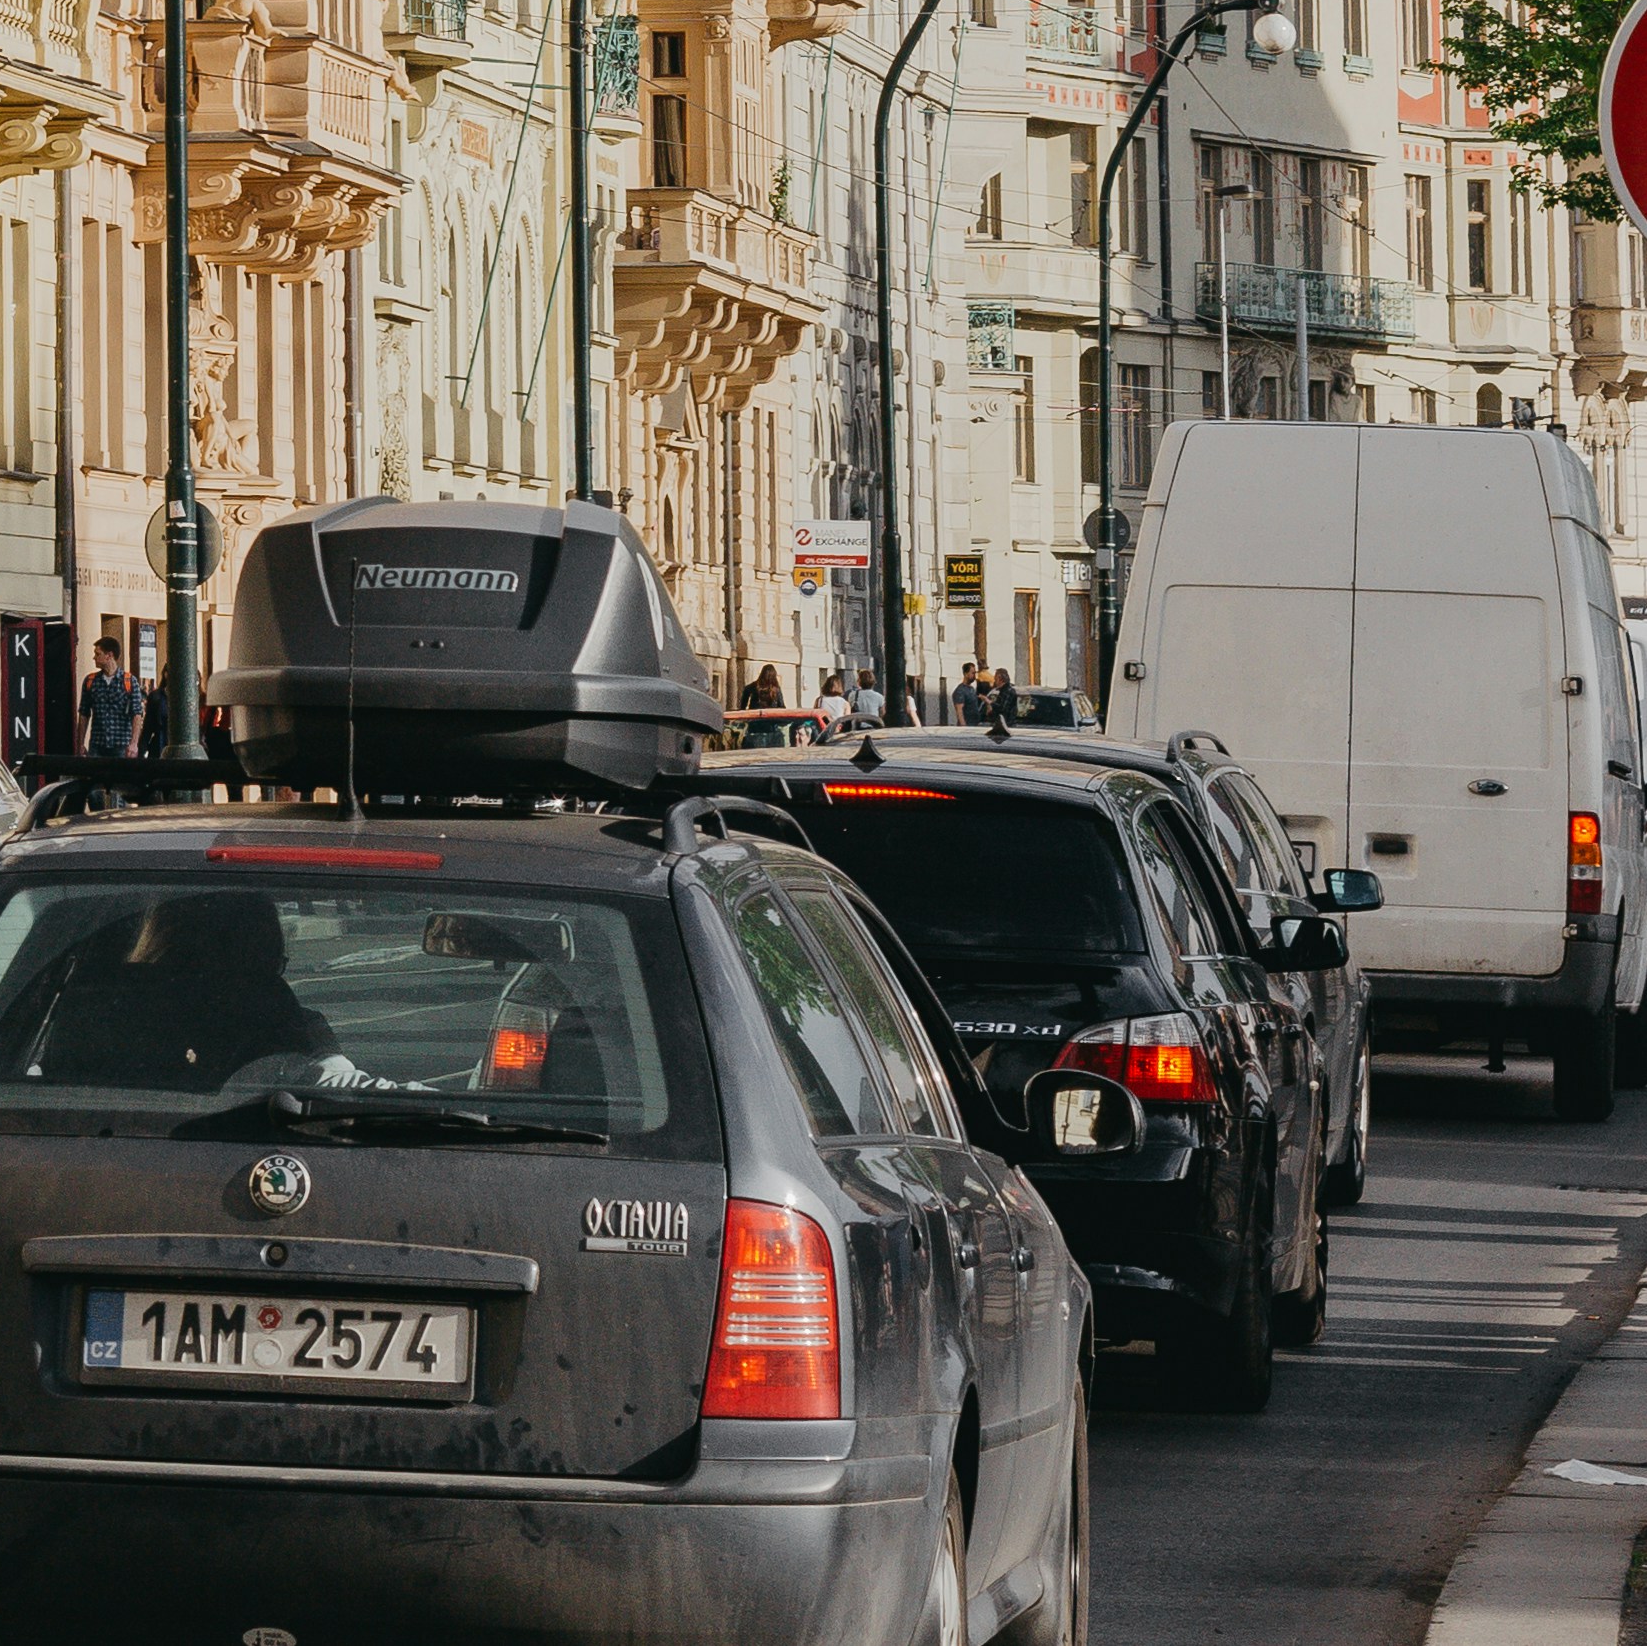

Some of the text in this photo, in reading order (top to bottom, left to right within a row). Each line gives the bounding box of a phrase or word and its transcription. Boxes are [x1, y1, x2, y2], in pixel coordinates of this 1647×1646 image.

[815, 538, 868, 546] EXCHANGE
[356, 566, 516, 590] Neumann
[953, 1021, 1016, 1033] 530
[585, 1197, 689, 1240] OCTAVIA
[631, 1242, 680, 1253] TOUR
[90, 1300, 438, 1373] CZ 1AM 2574
